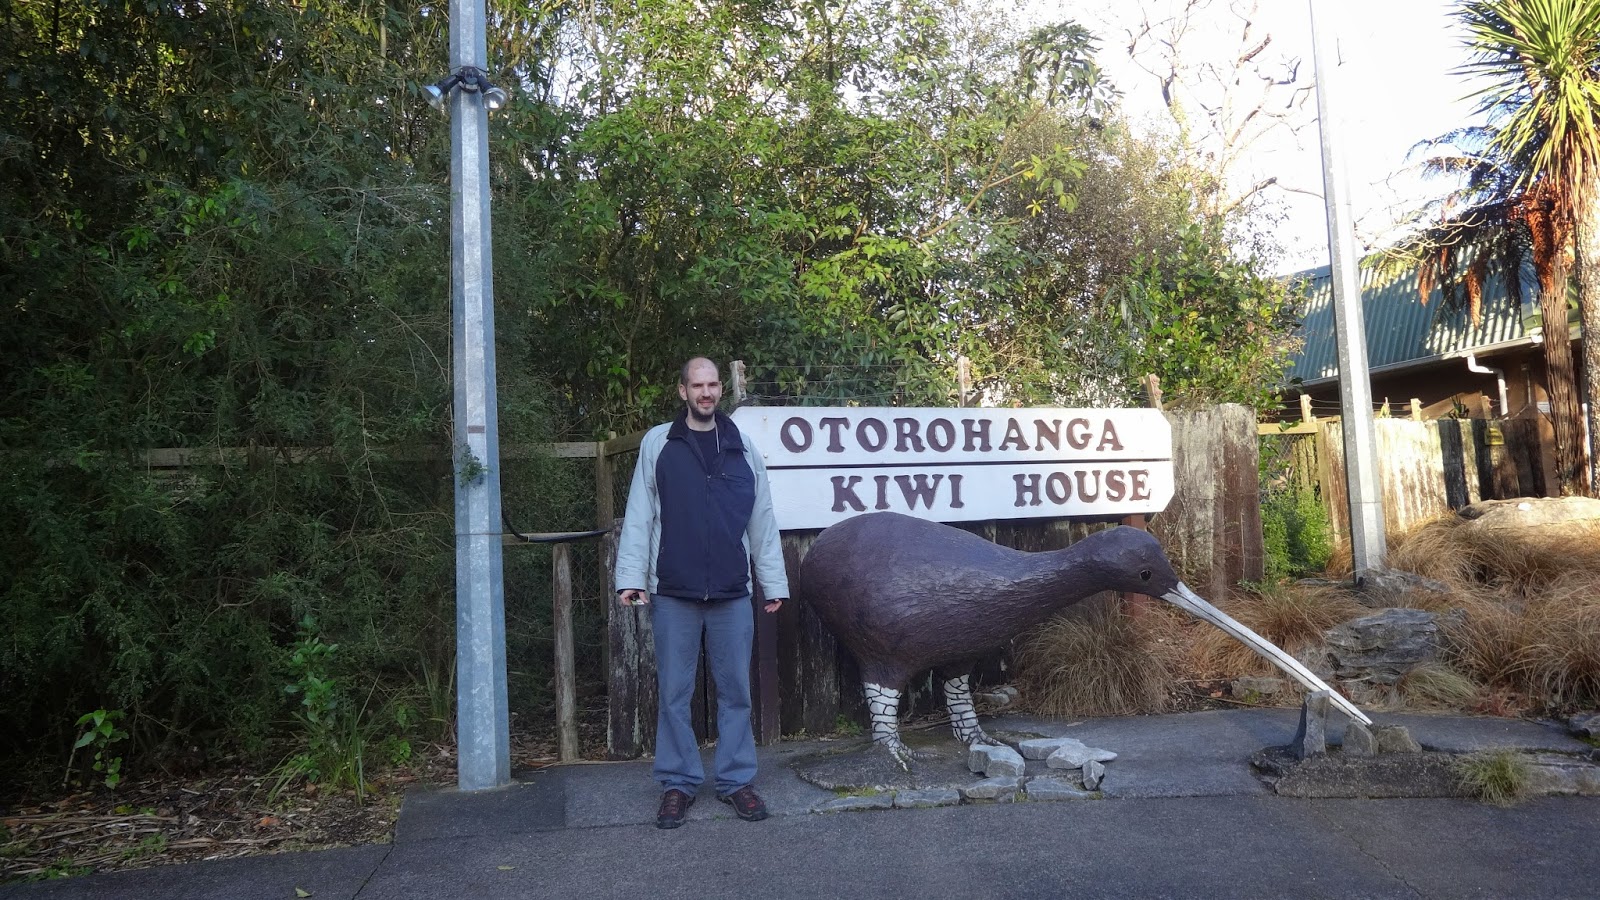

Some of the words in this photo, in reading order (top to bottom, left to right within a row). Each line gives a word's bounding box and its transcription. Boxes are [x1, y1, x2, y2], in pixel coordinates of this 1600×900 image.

[780, 416, 1124, 454] OTOROHANGA
[830, 474, 965, 513] KIWI
[1013, 469, 1152, 508] HOUSE
